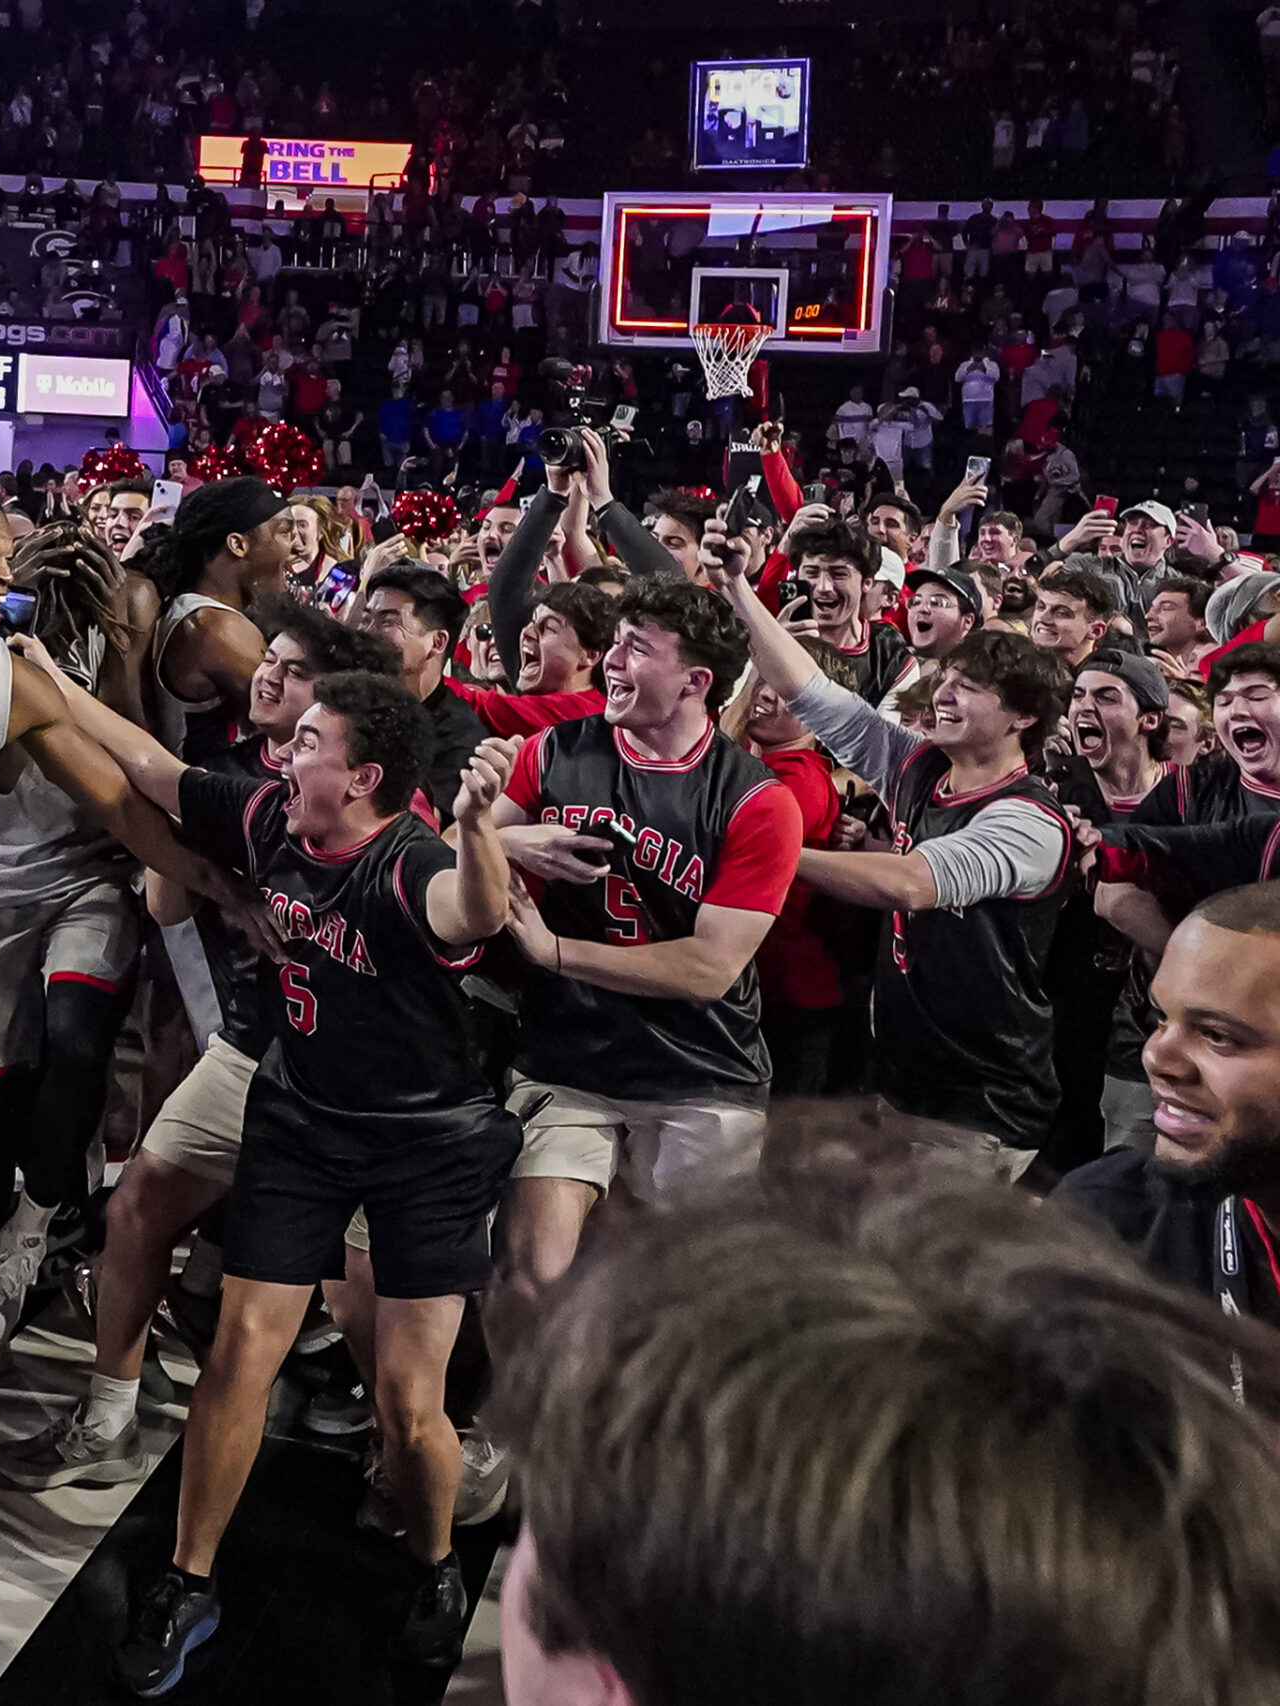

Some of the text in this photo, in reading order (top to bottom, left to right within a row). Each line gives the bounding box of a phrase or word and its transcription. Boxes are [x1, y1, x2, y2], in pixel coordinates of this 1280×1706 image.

[269, 141, 355, 158] RING THE
[269, 160, 348, 183] BELL
[260, 887, 377, 976] ORGIA
[605, 873, 651, 947] 5
[279, 960, 318, 1036] 5
